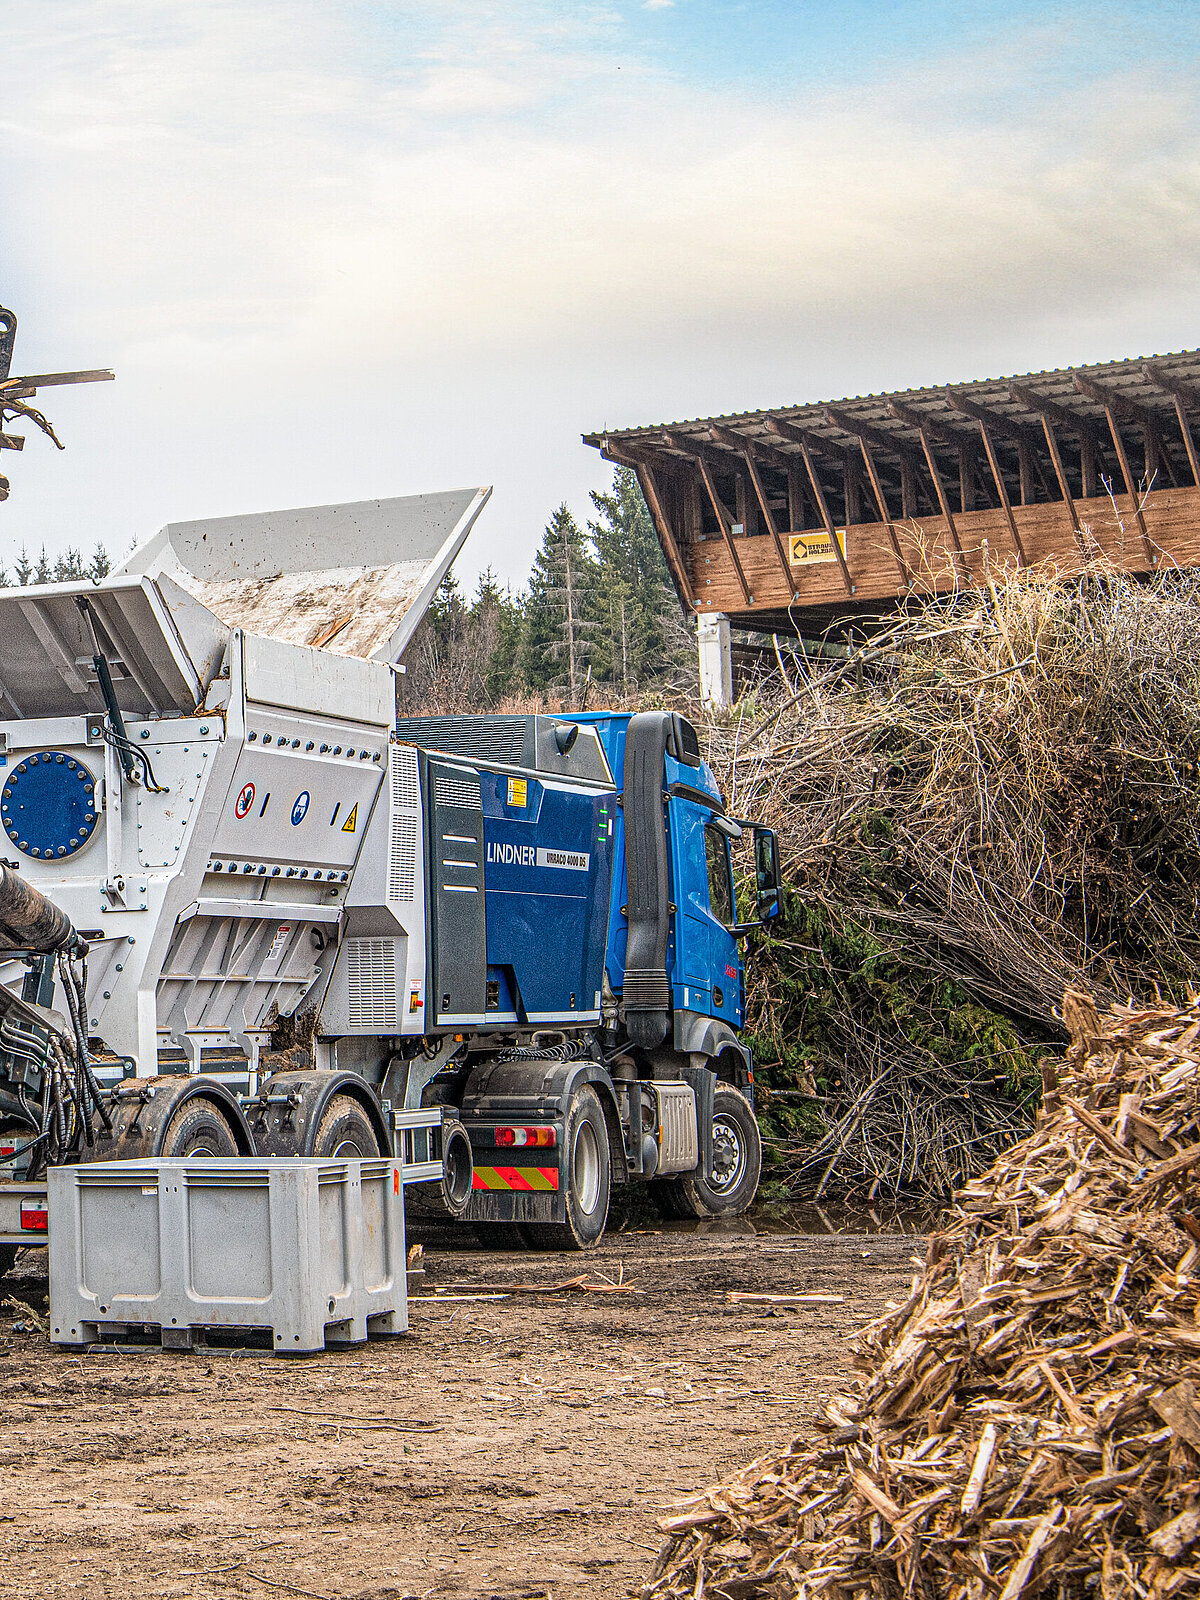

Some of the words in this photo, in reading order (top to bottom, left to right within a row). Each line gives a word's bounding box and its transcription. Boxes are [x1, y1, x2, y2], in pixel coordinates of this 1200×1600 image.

[487, 842, 535, 867] LINDNER
[546, 852, 566, 865] URRACO
[566, 854, 578, 867] 4000
[579, 856, 586, 868] DS
